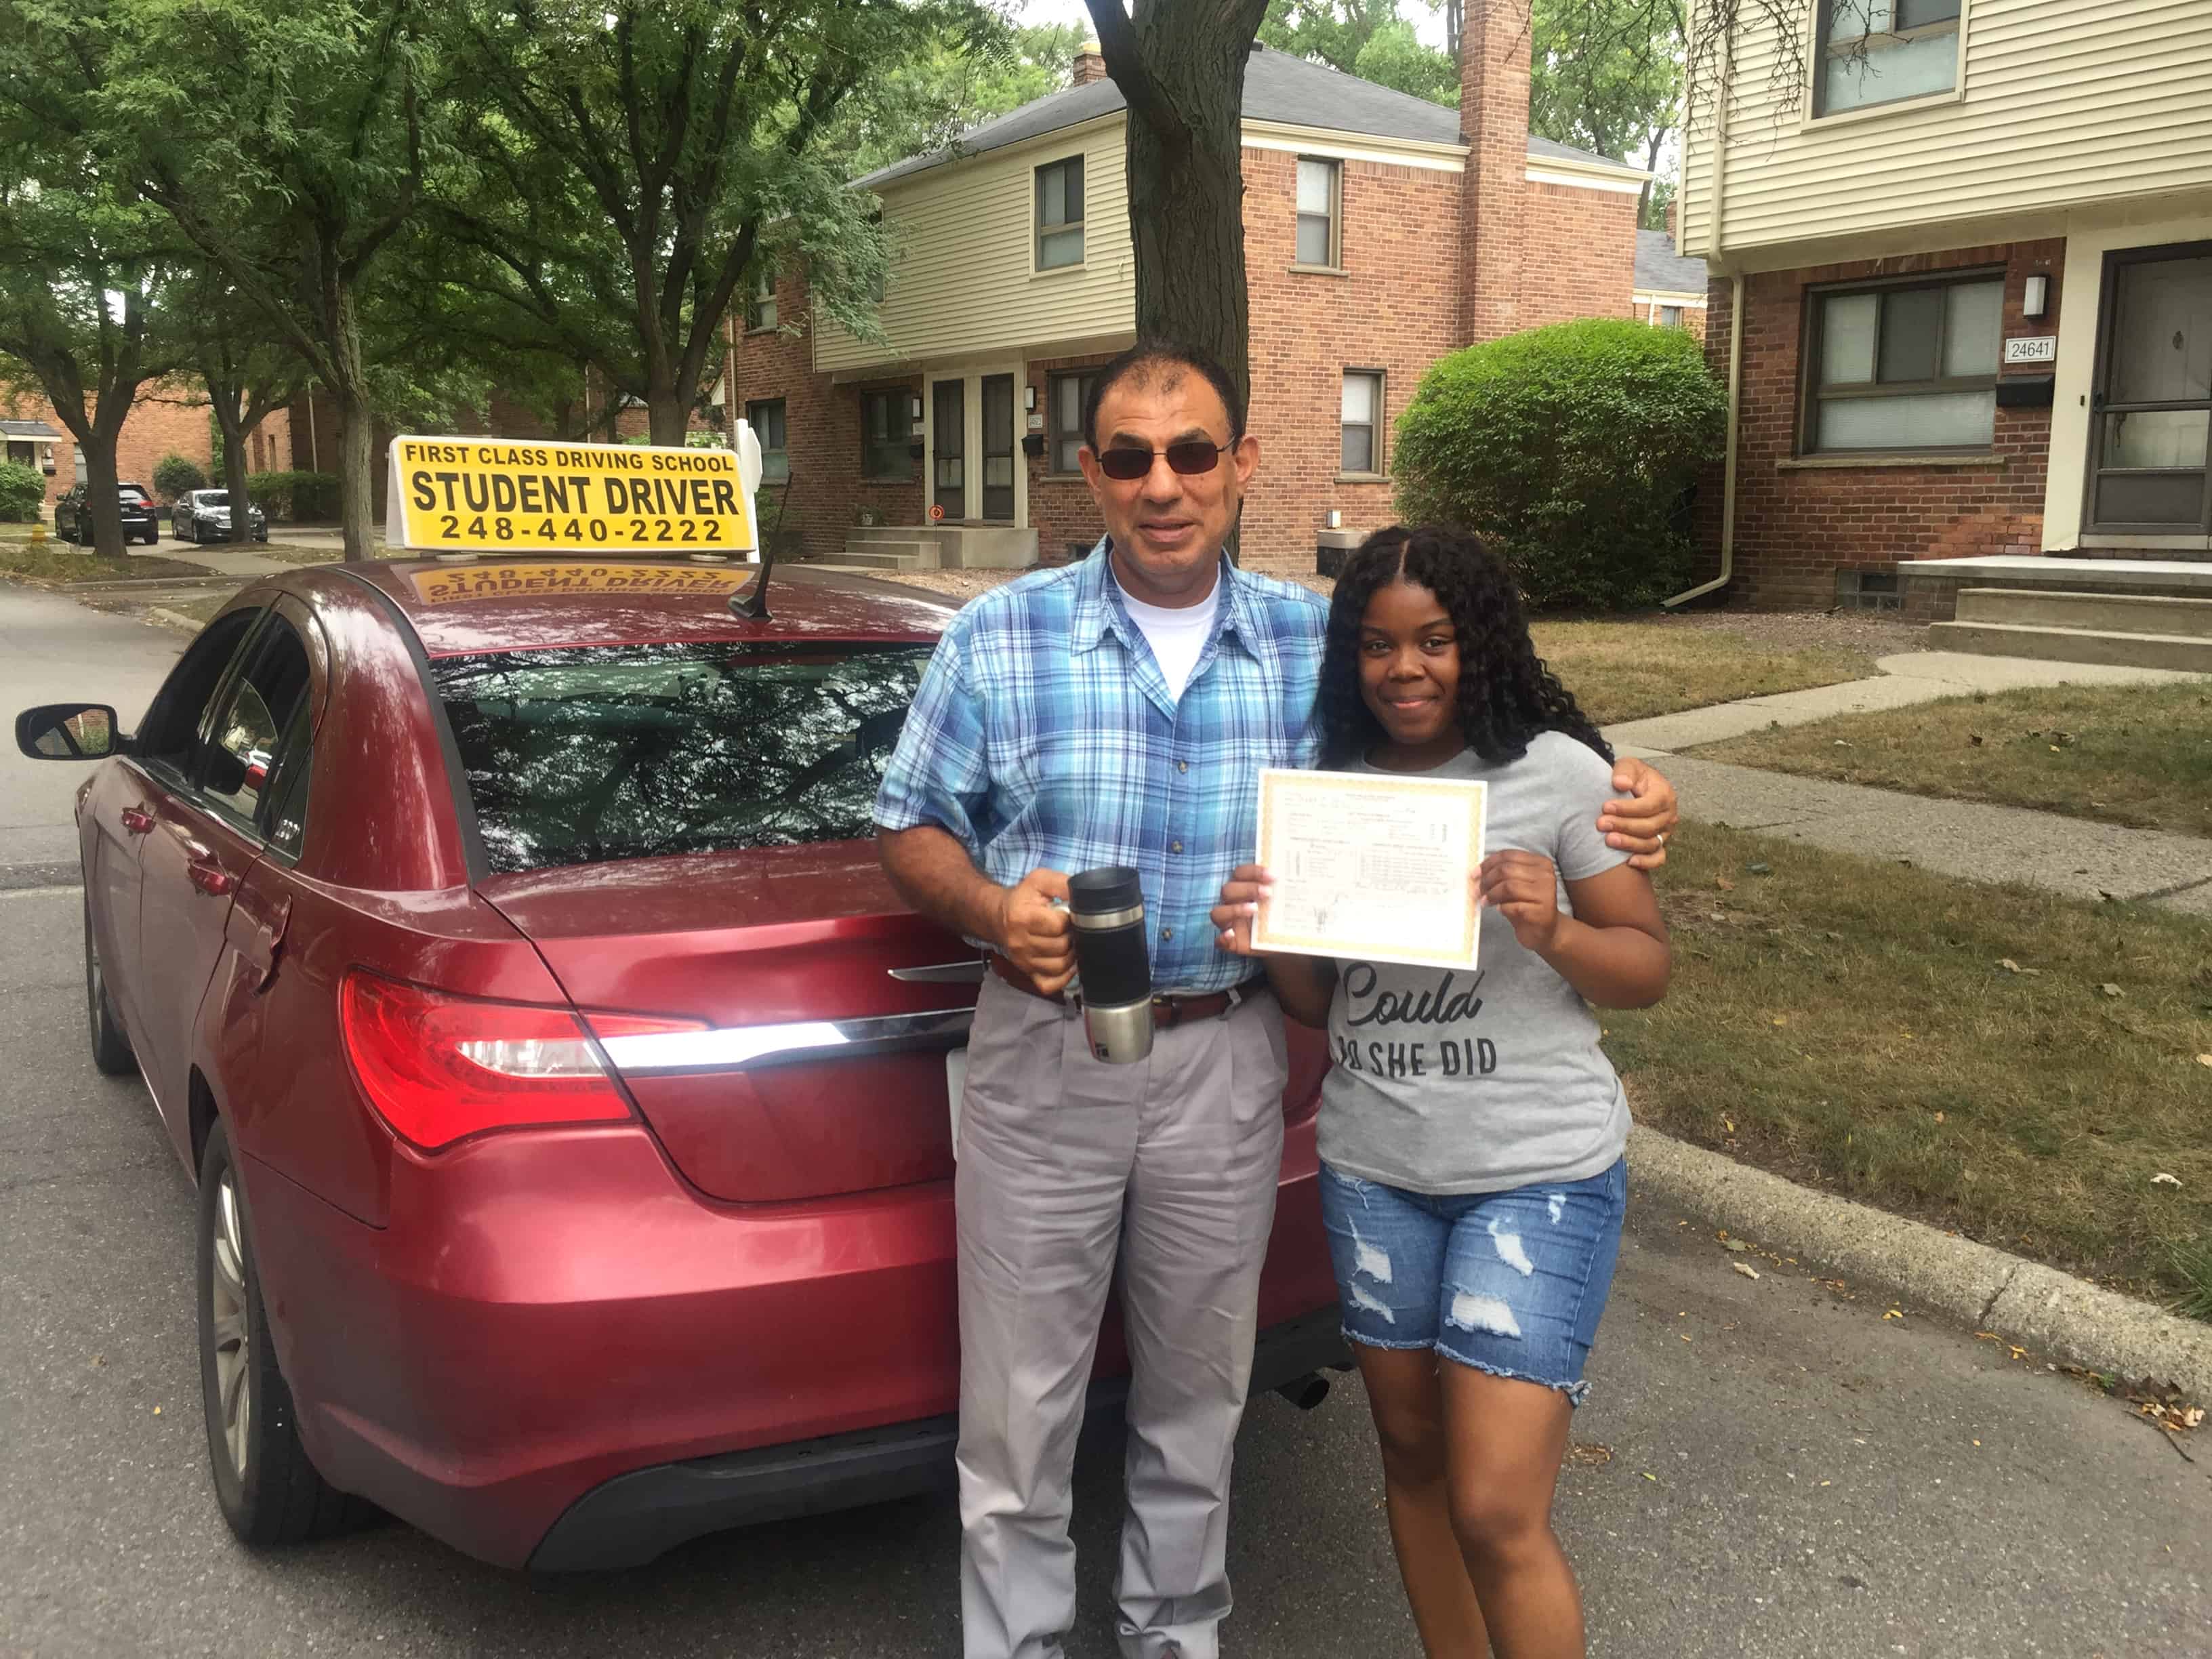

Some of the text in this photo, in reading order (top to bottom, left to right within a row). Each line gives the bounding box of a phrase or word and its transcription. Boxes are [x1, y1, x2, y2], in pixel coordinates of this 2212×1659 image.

[2011, 342, 2049, 358] 24641
[405, 445, 733, 472] FIRST CLASS DRIVING SCHOOL
[412, 470, 739, 516] STUDENT DRIVER
[440, 515, 722, 541] 248-440-2222
[1343, 962, 1485, 1026] Could
[1369, 1041, 1427, 1079] SHE
[1440, 1038, 1496, 1076] DID
